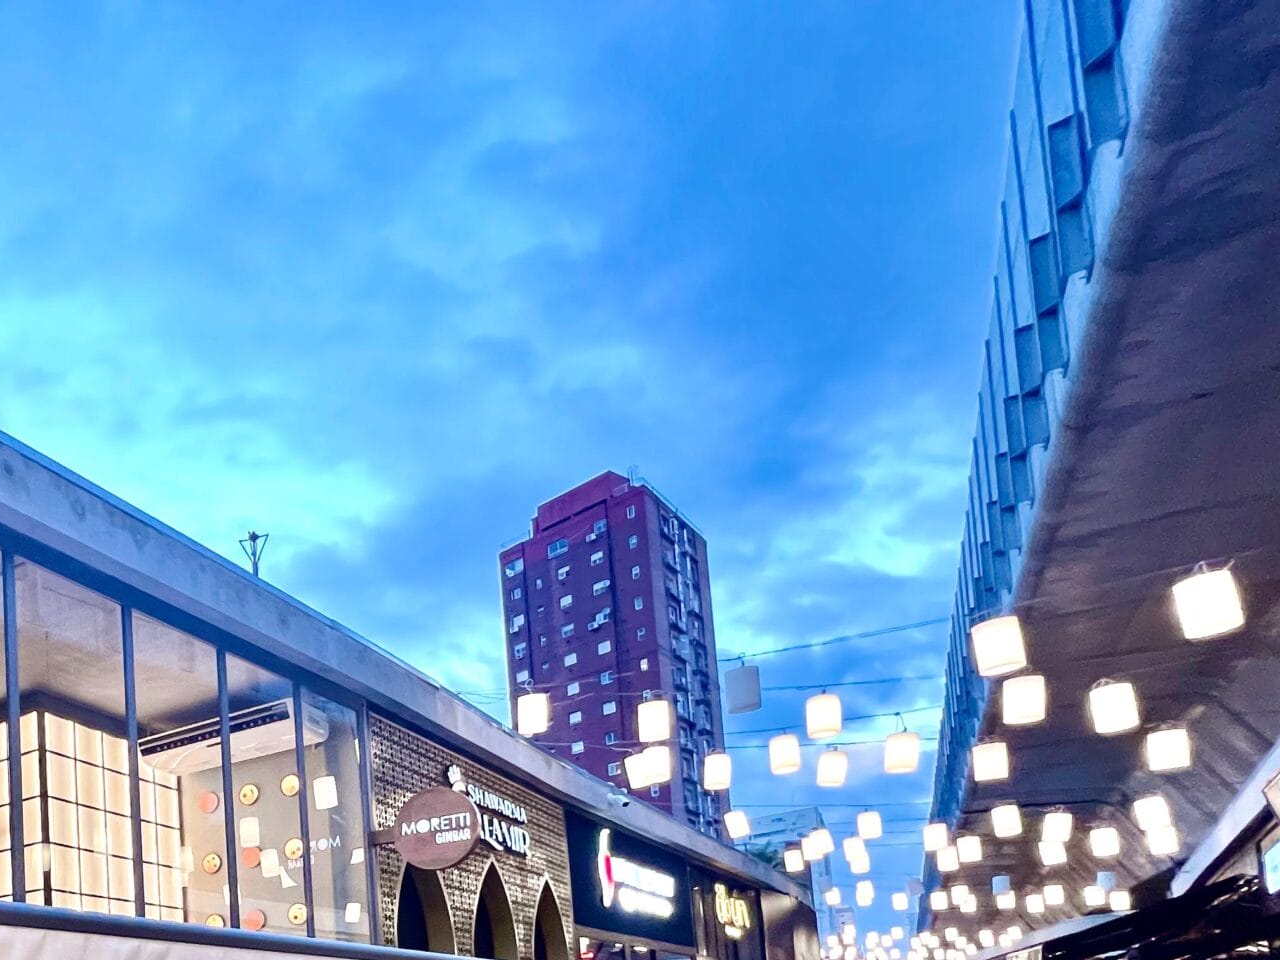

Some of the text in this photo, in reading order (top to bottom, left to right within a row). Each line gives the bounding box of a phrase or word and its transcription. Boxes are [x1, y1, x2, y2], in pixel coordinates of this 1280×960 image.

[467, 783, 528, 824] SHAWARMA
[401, 812, 470, 836] MORETTI
[435, 828, 471, 845] GINBAR
